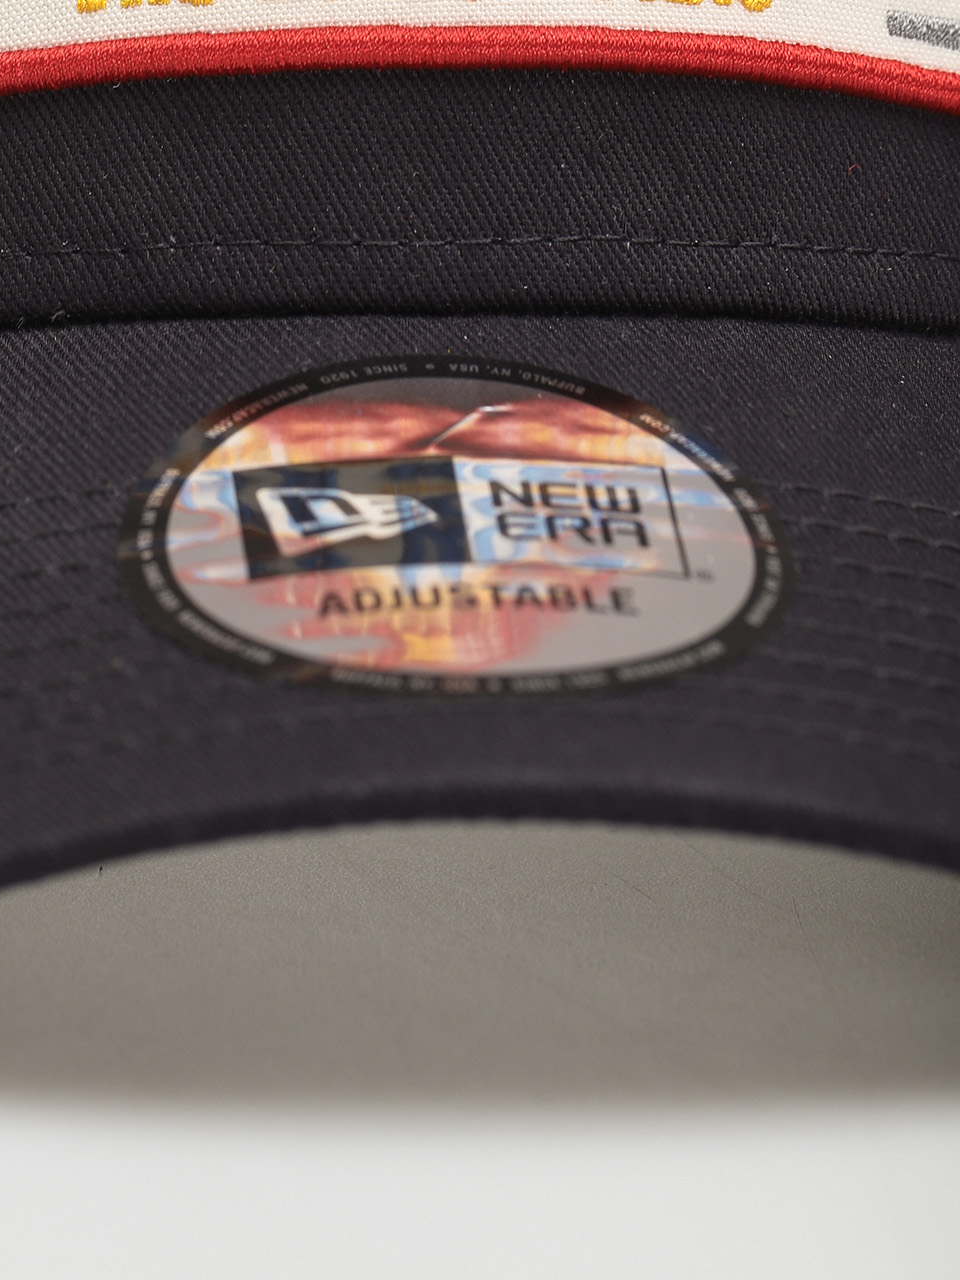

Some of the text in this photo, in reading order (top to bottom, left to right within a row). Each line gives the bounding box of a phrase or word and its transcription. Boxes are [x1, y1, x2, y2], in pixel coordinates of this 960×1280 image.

[320, 368, 359, 385] 1920
[364, 363, 409, 378] SINCE
[490, 480, 642, 514] NEW
[497, 512, 650, 548] ERA
[318, 583, 638, 618] ADJUSTABLE
